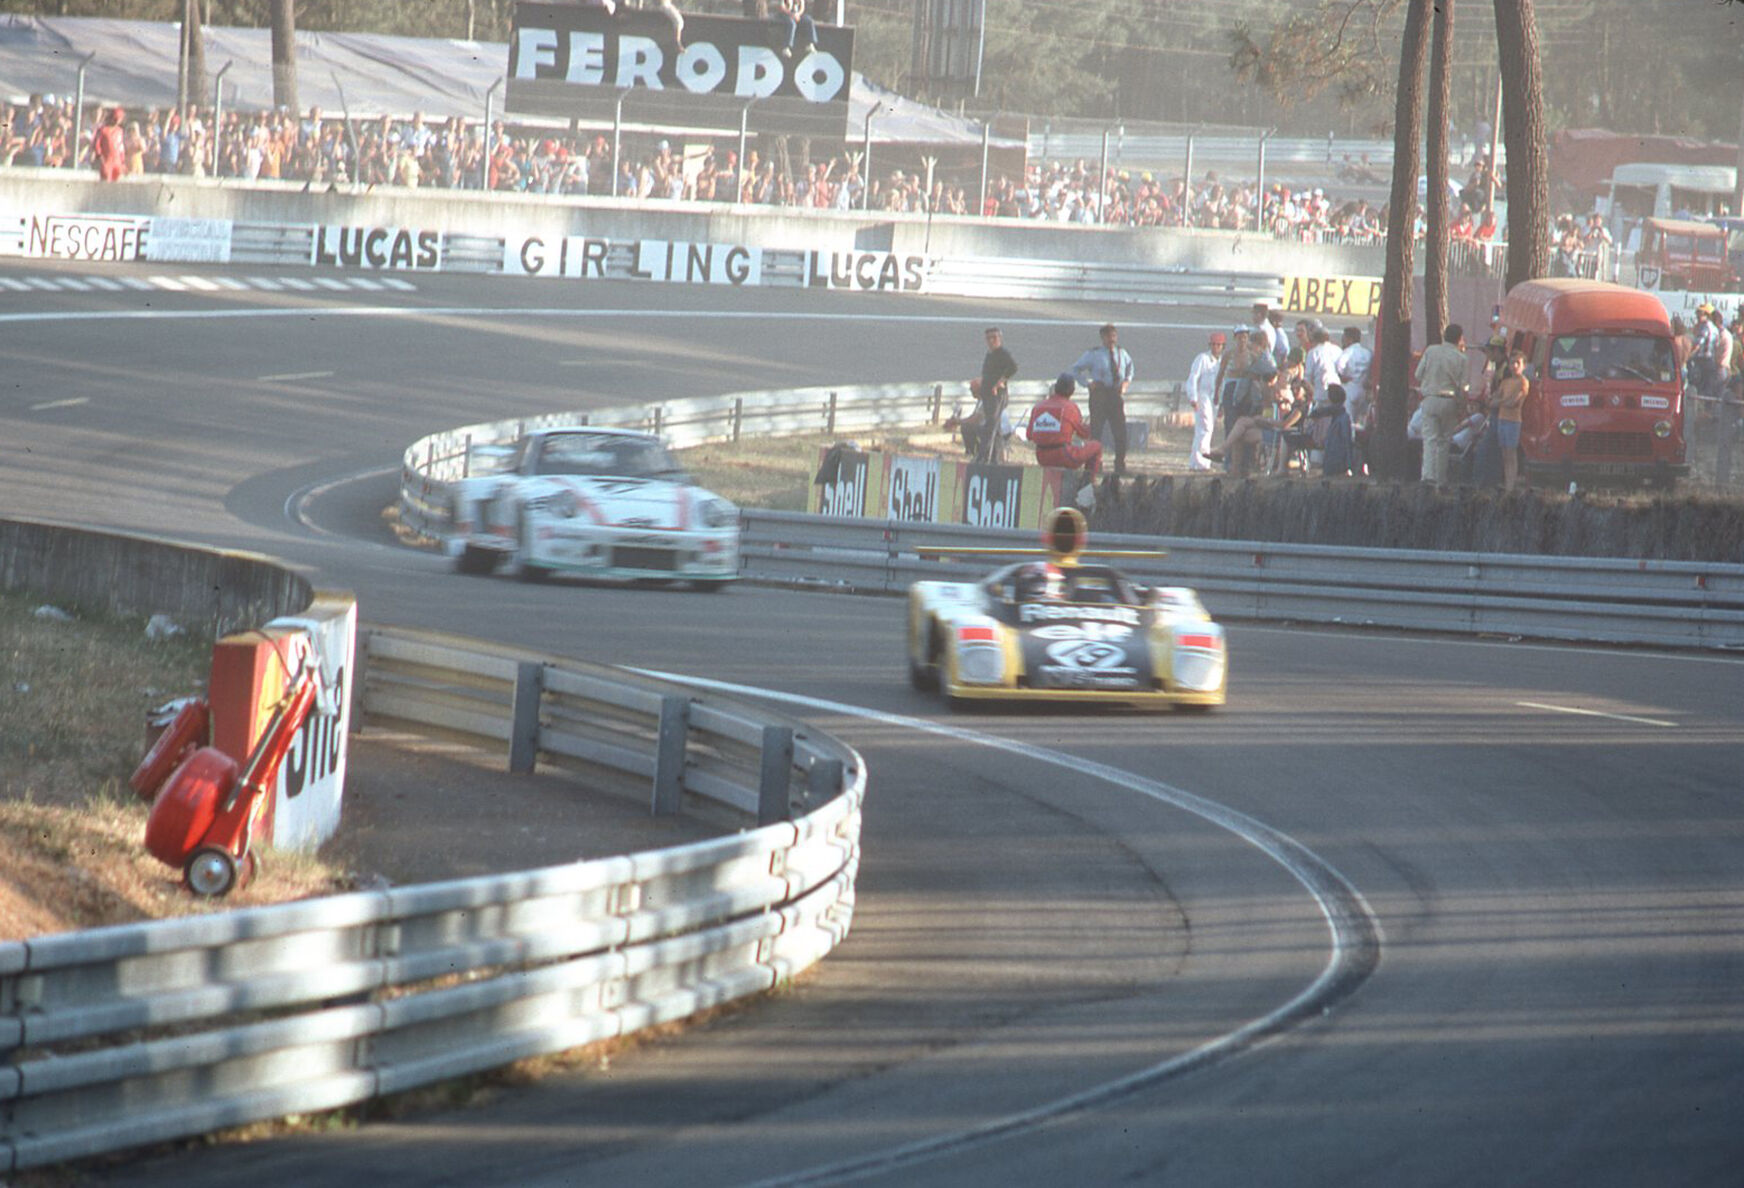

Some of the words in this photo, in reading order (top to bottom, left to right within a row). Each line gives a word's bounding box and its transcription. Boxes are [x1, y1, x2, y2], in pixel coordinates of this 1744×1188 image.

[515, 27, 845, 103] FERODO
[316, 226, 438, 269] LUCAS
[520, 237, 751, 285] GIRLING
[809, 251, 924, 291] LUCAS
[1288, 278, 1353, 314] ABEX
[891, 467, 936, 523] Shell
[966, 475, 1019, 529] Shell
[1030, 621, 1134, 643] elf
